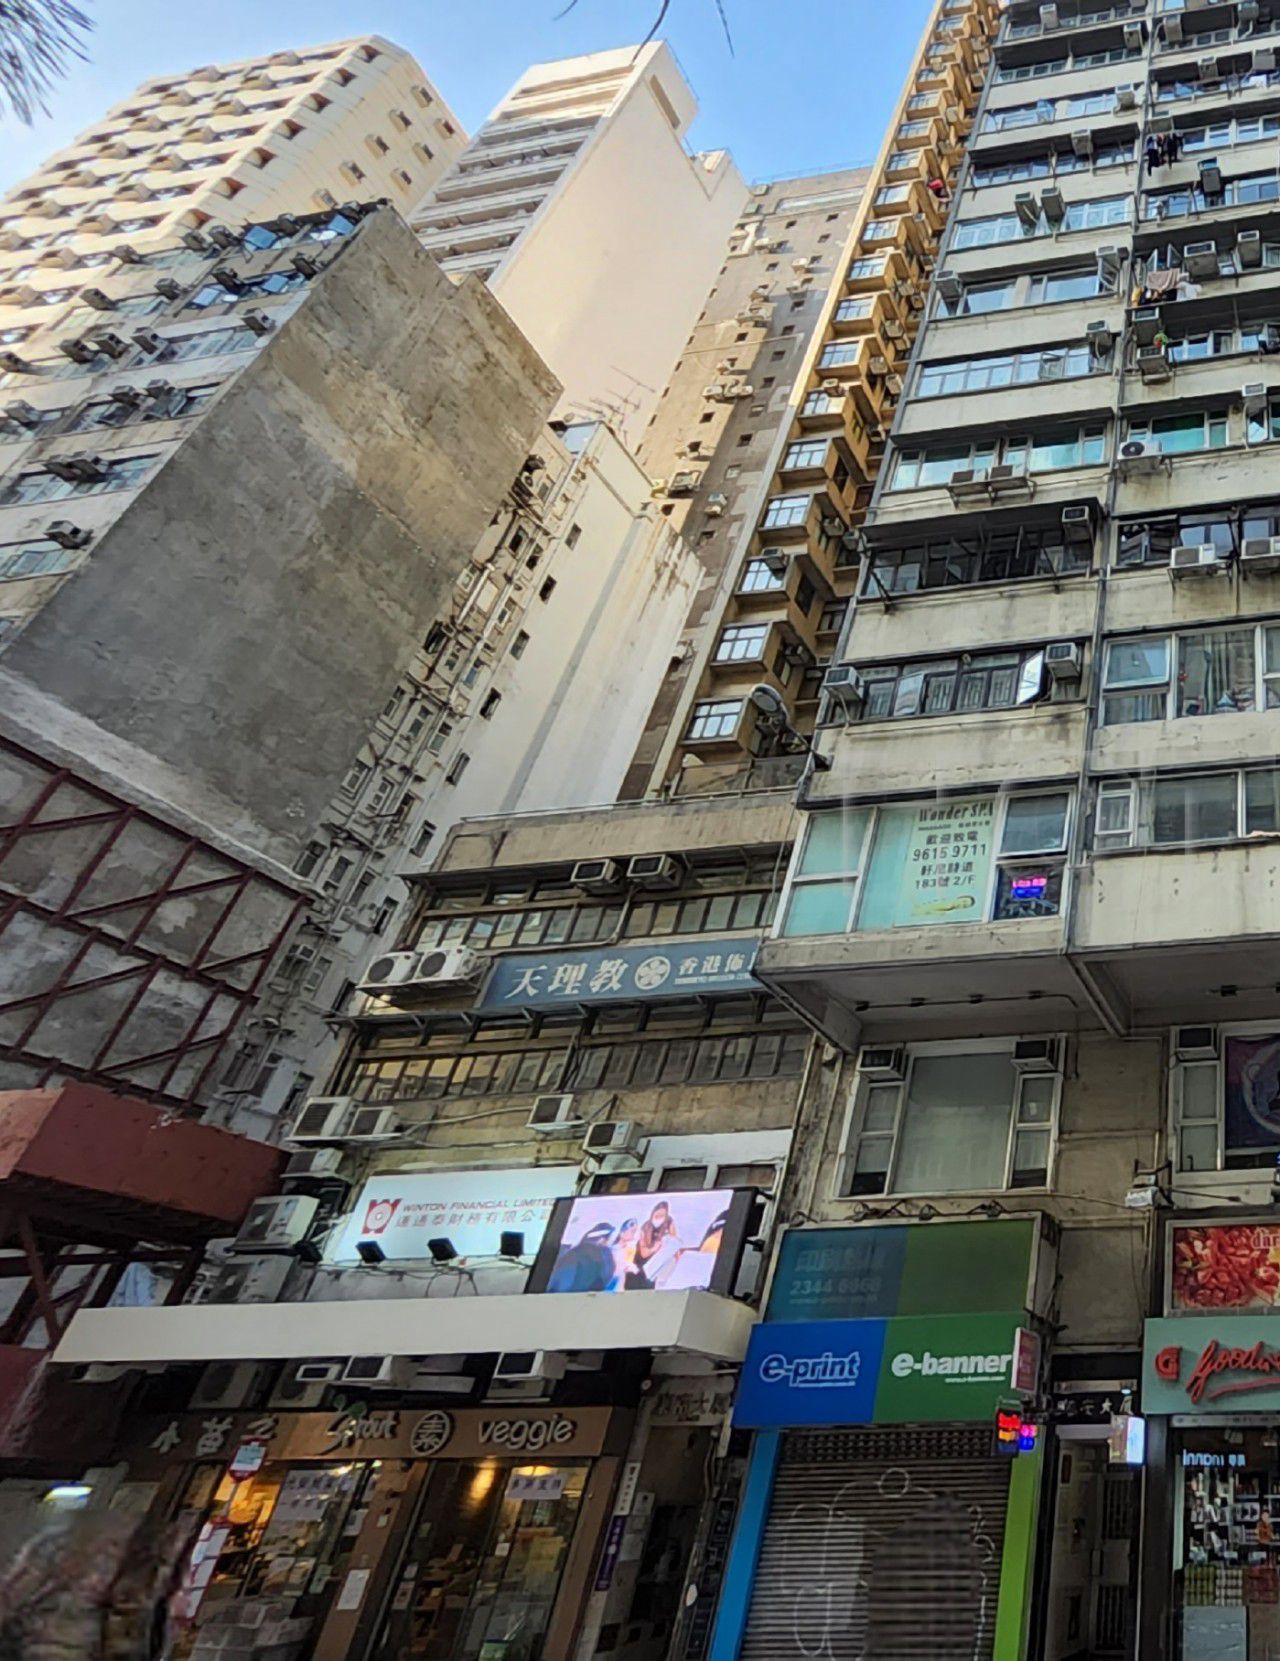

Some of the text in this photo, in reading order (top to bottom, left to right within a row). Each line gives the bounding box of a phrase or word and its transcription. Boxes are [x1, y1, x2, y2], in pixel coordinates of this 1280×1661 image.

[912, 843, 987, 862] 9615 9711
[504, 958, 630, 1000] 天理教
[760, 1351, 861, 1388] e-print
[891, 1351, 1014, 1378] e-banner
[478, 1414, 575, 1452] veggie
